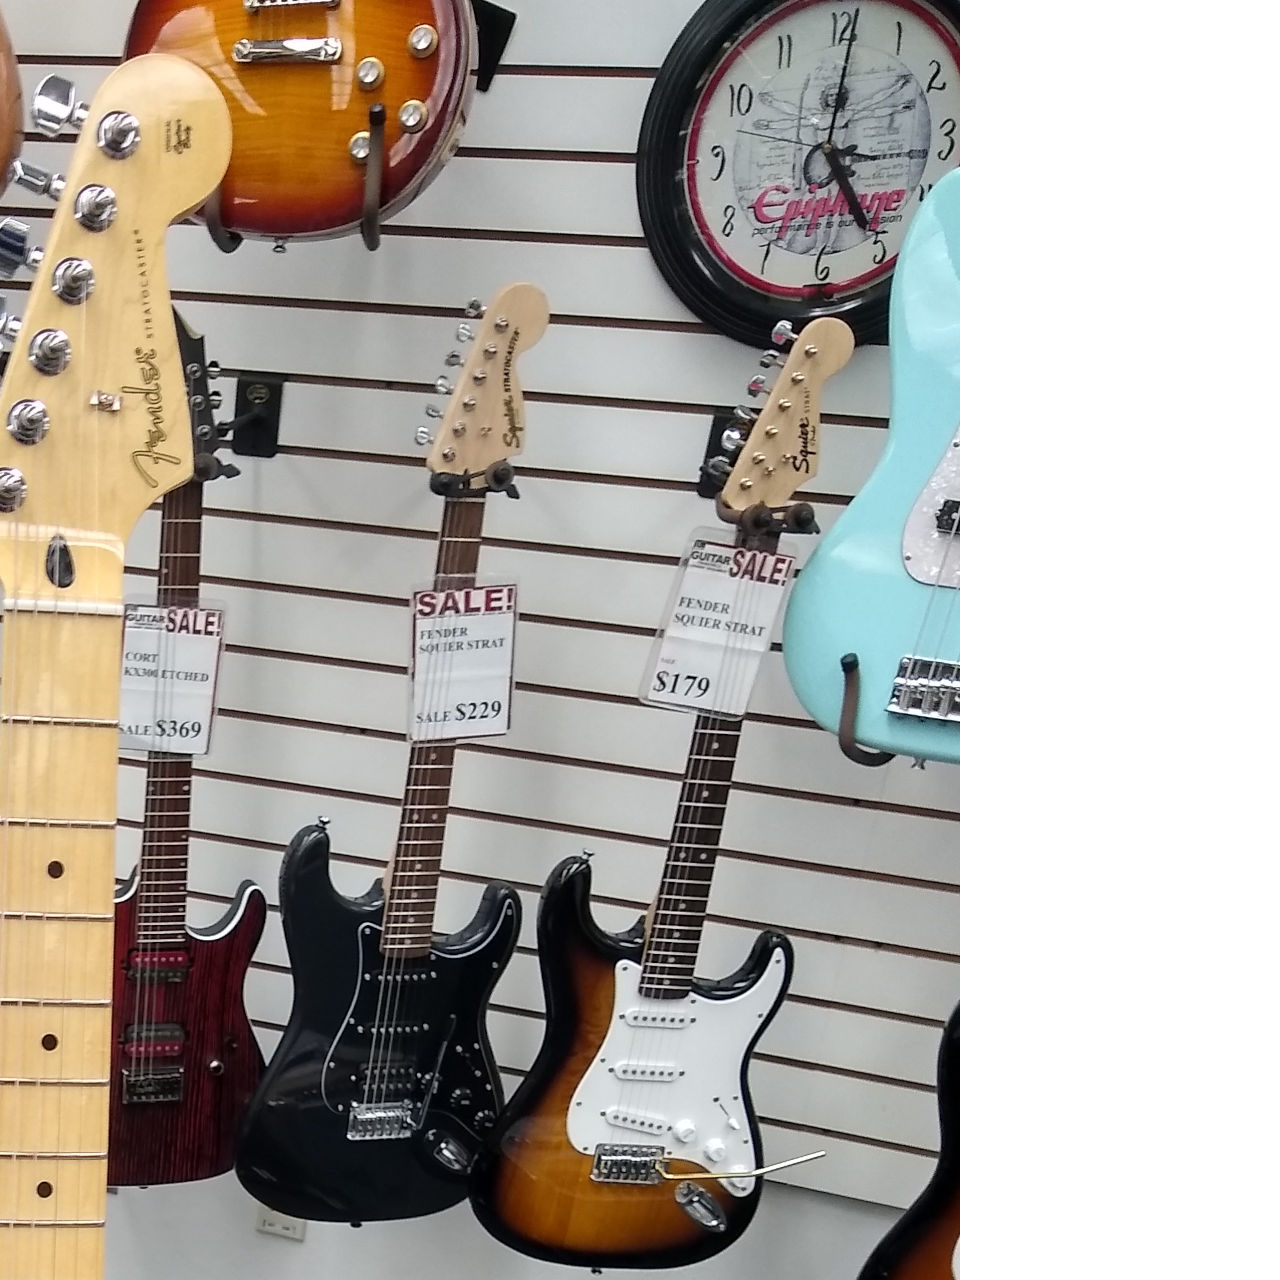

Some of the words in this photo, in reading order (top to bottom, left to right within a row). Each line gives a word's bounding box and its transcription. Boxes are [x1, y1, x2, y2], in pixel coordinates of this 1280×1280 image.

[831, 11, 852, 44] 12
[778, 34, 792, 69] 11
[926, 60, 946, 93] 2
[729, 83, 753, 117] 10
[938, 118, 956, 161] 3
[712, 146, 726, 181] 9
[723, 205, 736, 237] 8
[759, 242, 773, 275] 7
[815, 244, 830, 281] 6
[871, 230, 889, 264] 5
[135, 235, 154, 340] STRATOCASTER
[122, 346, 181, 490] Fender
[792, 416, 817, 474] Squier
[691, 551, 731, 566] GUITAR
[730, 549, 794, 587] SALE!
[417, 587, 515, 617] SALE!
[678, 596, 731, 614] FENDER
[127, 613, 165, 625] GUITAR
[165, 608, 223, 637] SALE!
[420, 626, 468, 640] FENDER
[673, 612, 722, 630] SQUIER
[724, 621, 767, 638] STRAT
[125, 651, 159, 664] CORT
[419, 640, 464, 655] SQUIER
[466, 637, 506, 650] STRAT
[161, 669, 209, 683] ETCHED
[652, 669, 711, 699] $179
[416, 710, 452, 724] SALE
[455, 700, 502, 722] $229
[155, 719, 202, 739] $369
